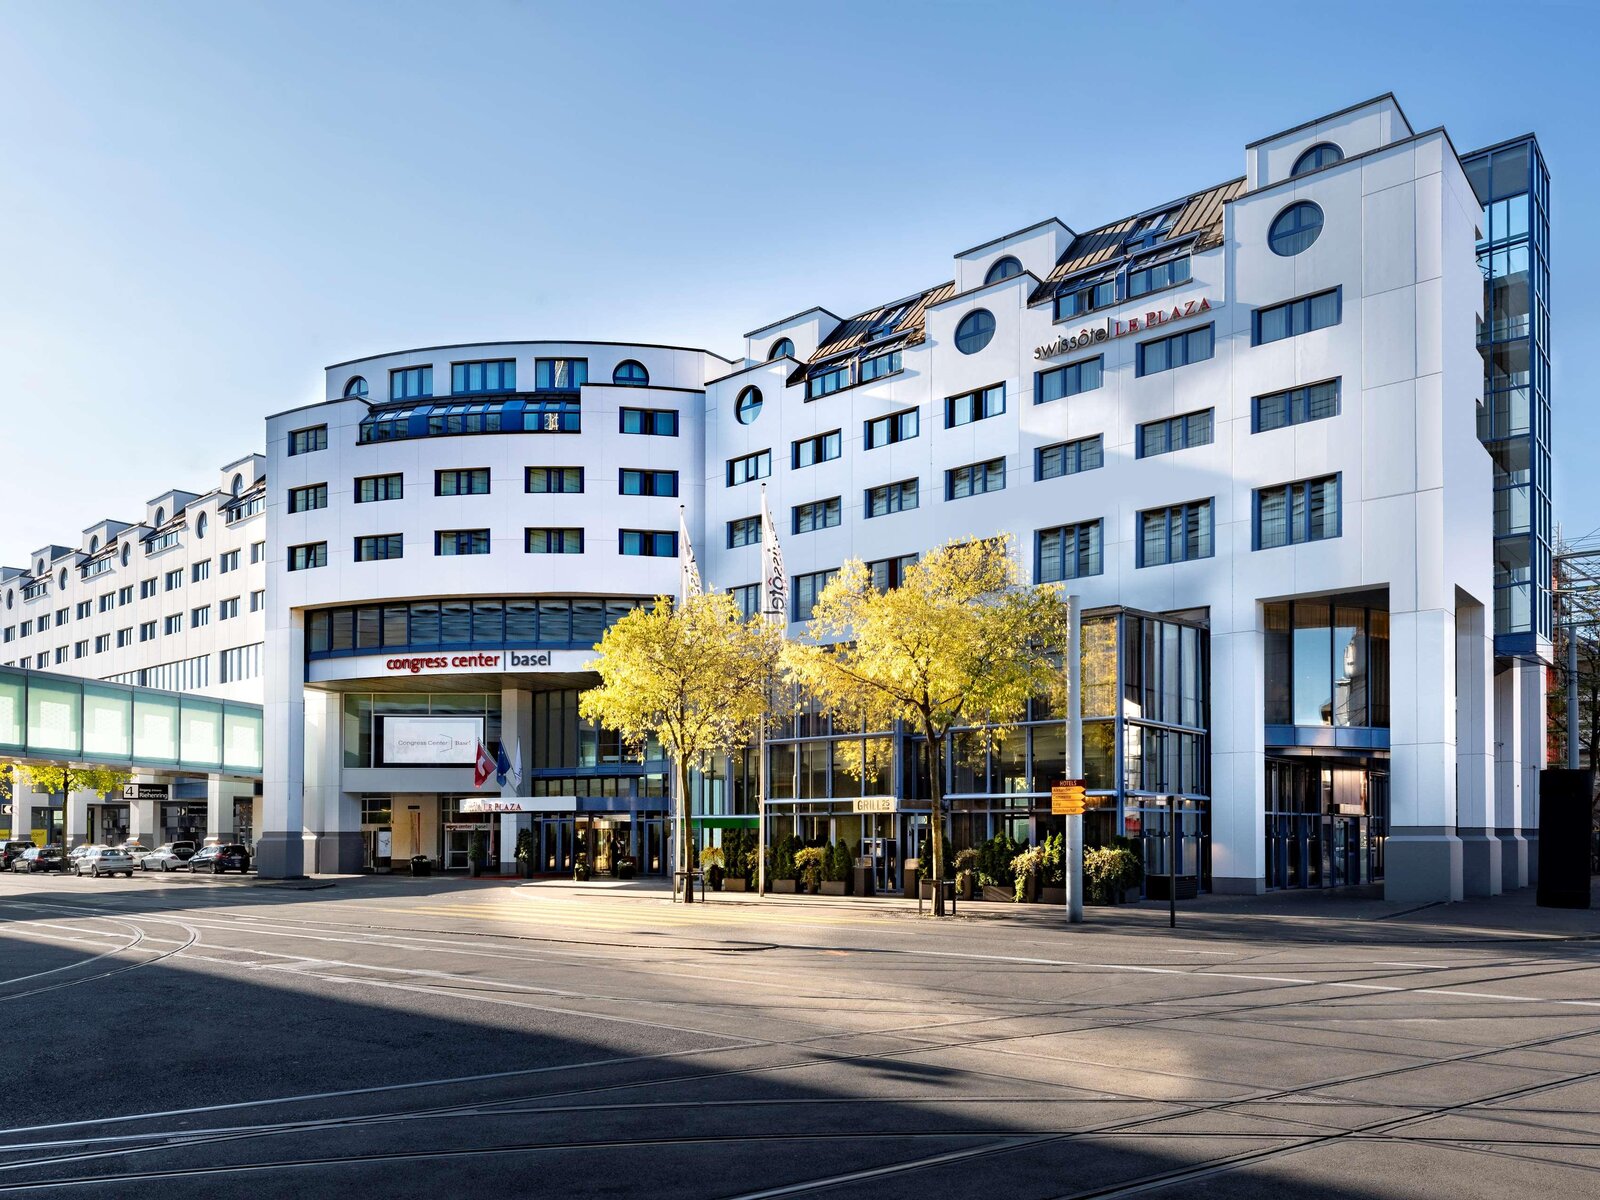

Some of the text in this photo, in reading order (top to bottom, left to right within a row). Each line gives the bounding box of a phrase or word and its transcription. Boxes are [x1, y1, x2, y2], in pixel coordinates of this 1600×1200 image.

[1034, 297, 1211, 360] swissôtel LE PLAZA
[386, 651, 551, 673] congress center basel
[125, 786, 134, 797] 4
[495, 802, 522, 811] PLAZA
[857, 800, 880, 811] GRILL
